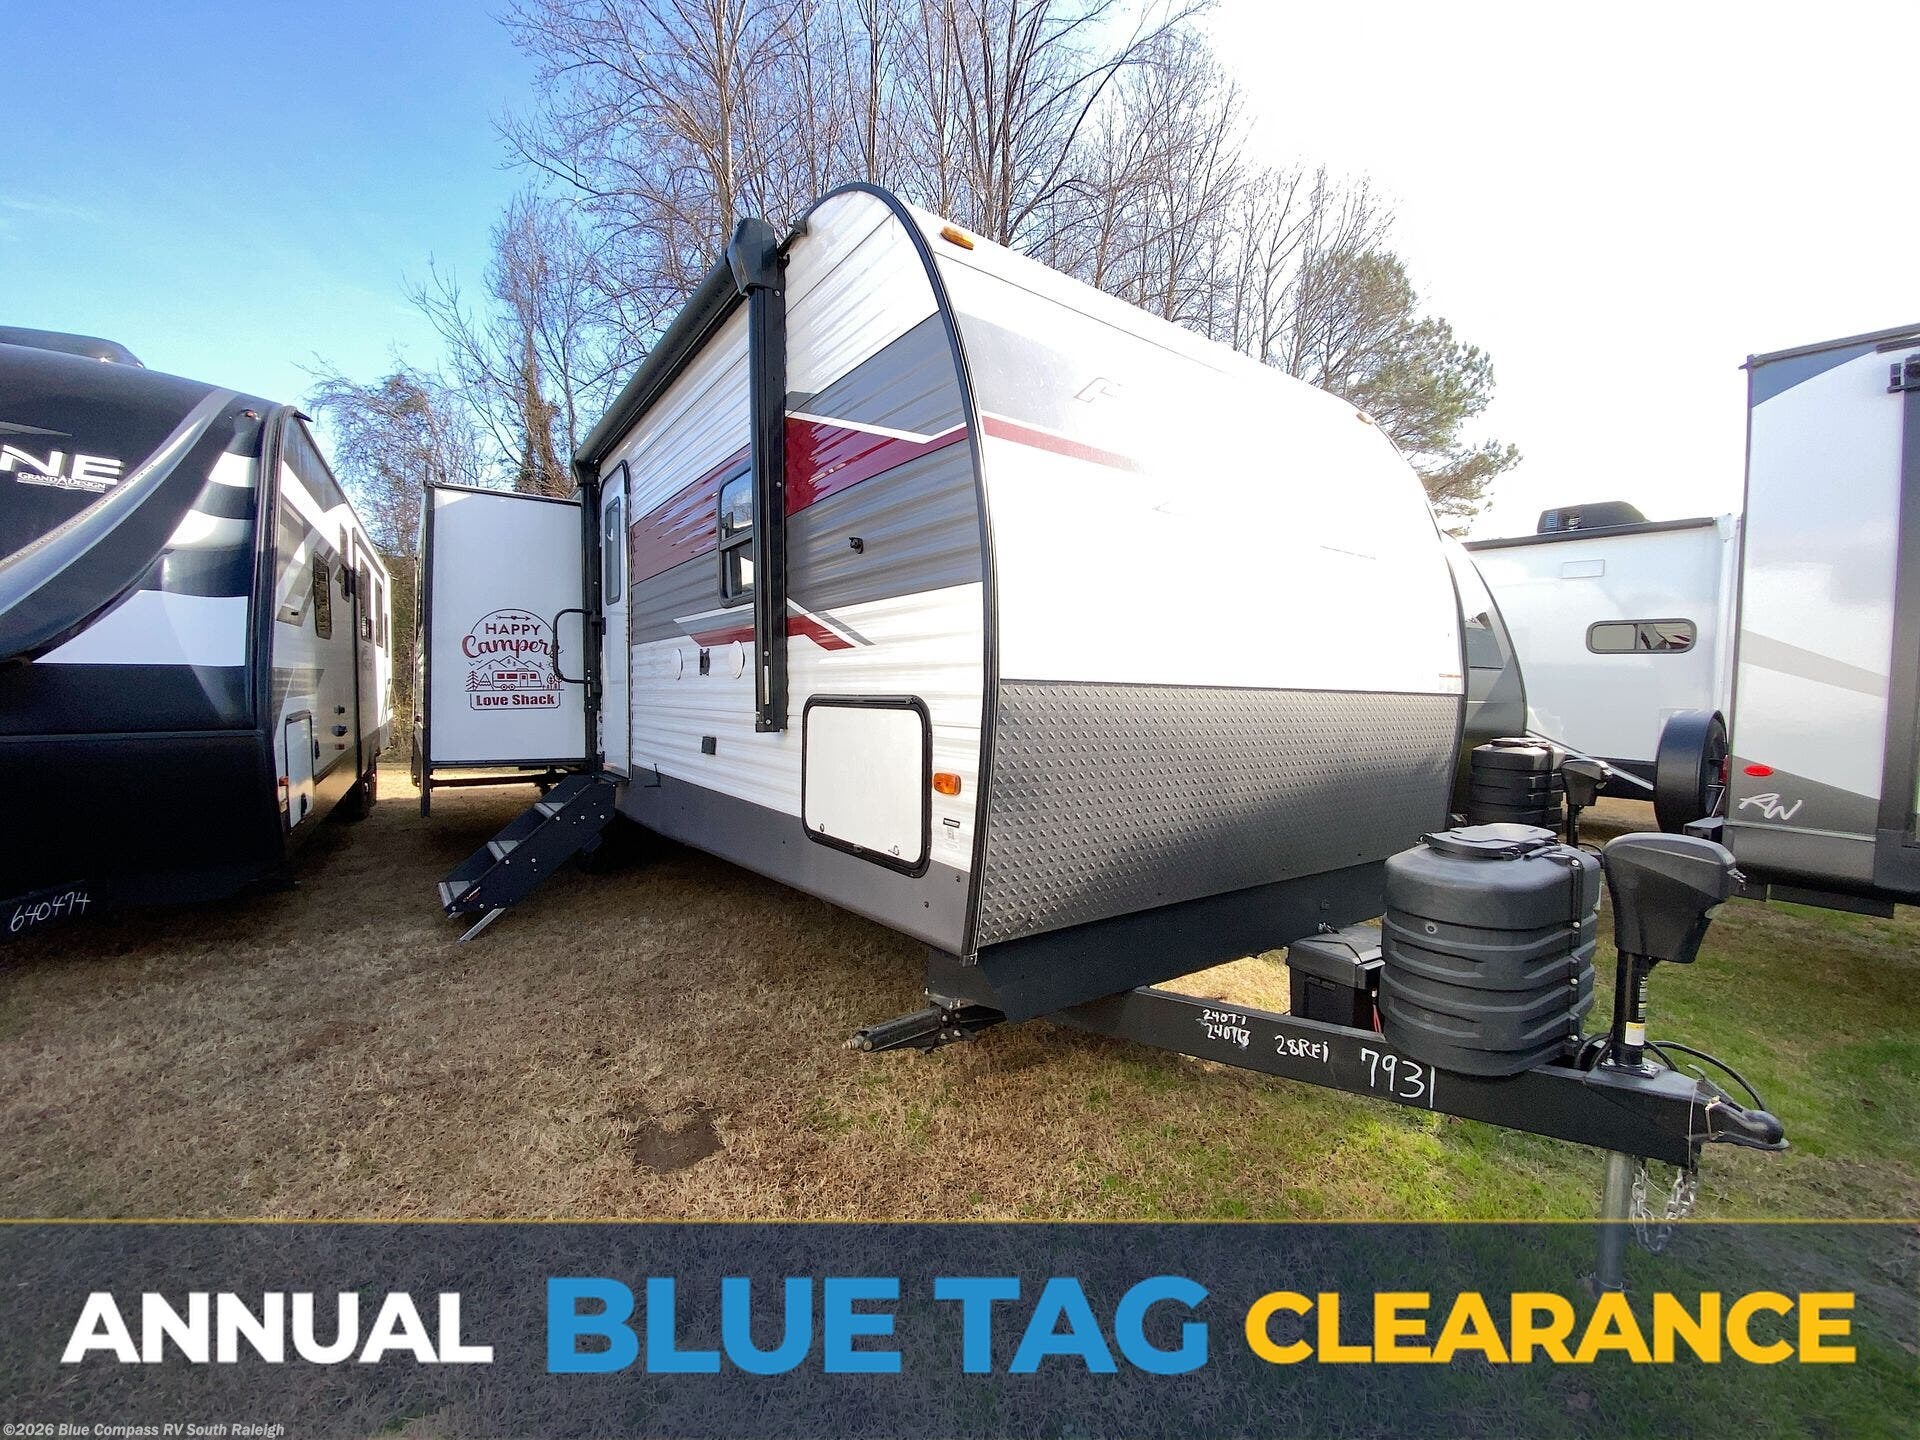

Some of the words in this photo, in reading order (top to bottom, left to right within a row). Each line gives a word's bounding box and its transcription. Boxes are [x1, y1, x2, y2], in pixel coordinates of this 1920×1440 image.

[485, 622, 541, 635] HAPPY
[476, 694, 508, 706] Love
[512, 694, 555, 705] Shack
[10, 891, 91, 932] 640474
[1360, 1047, 1436, 1109] 7931
